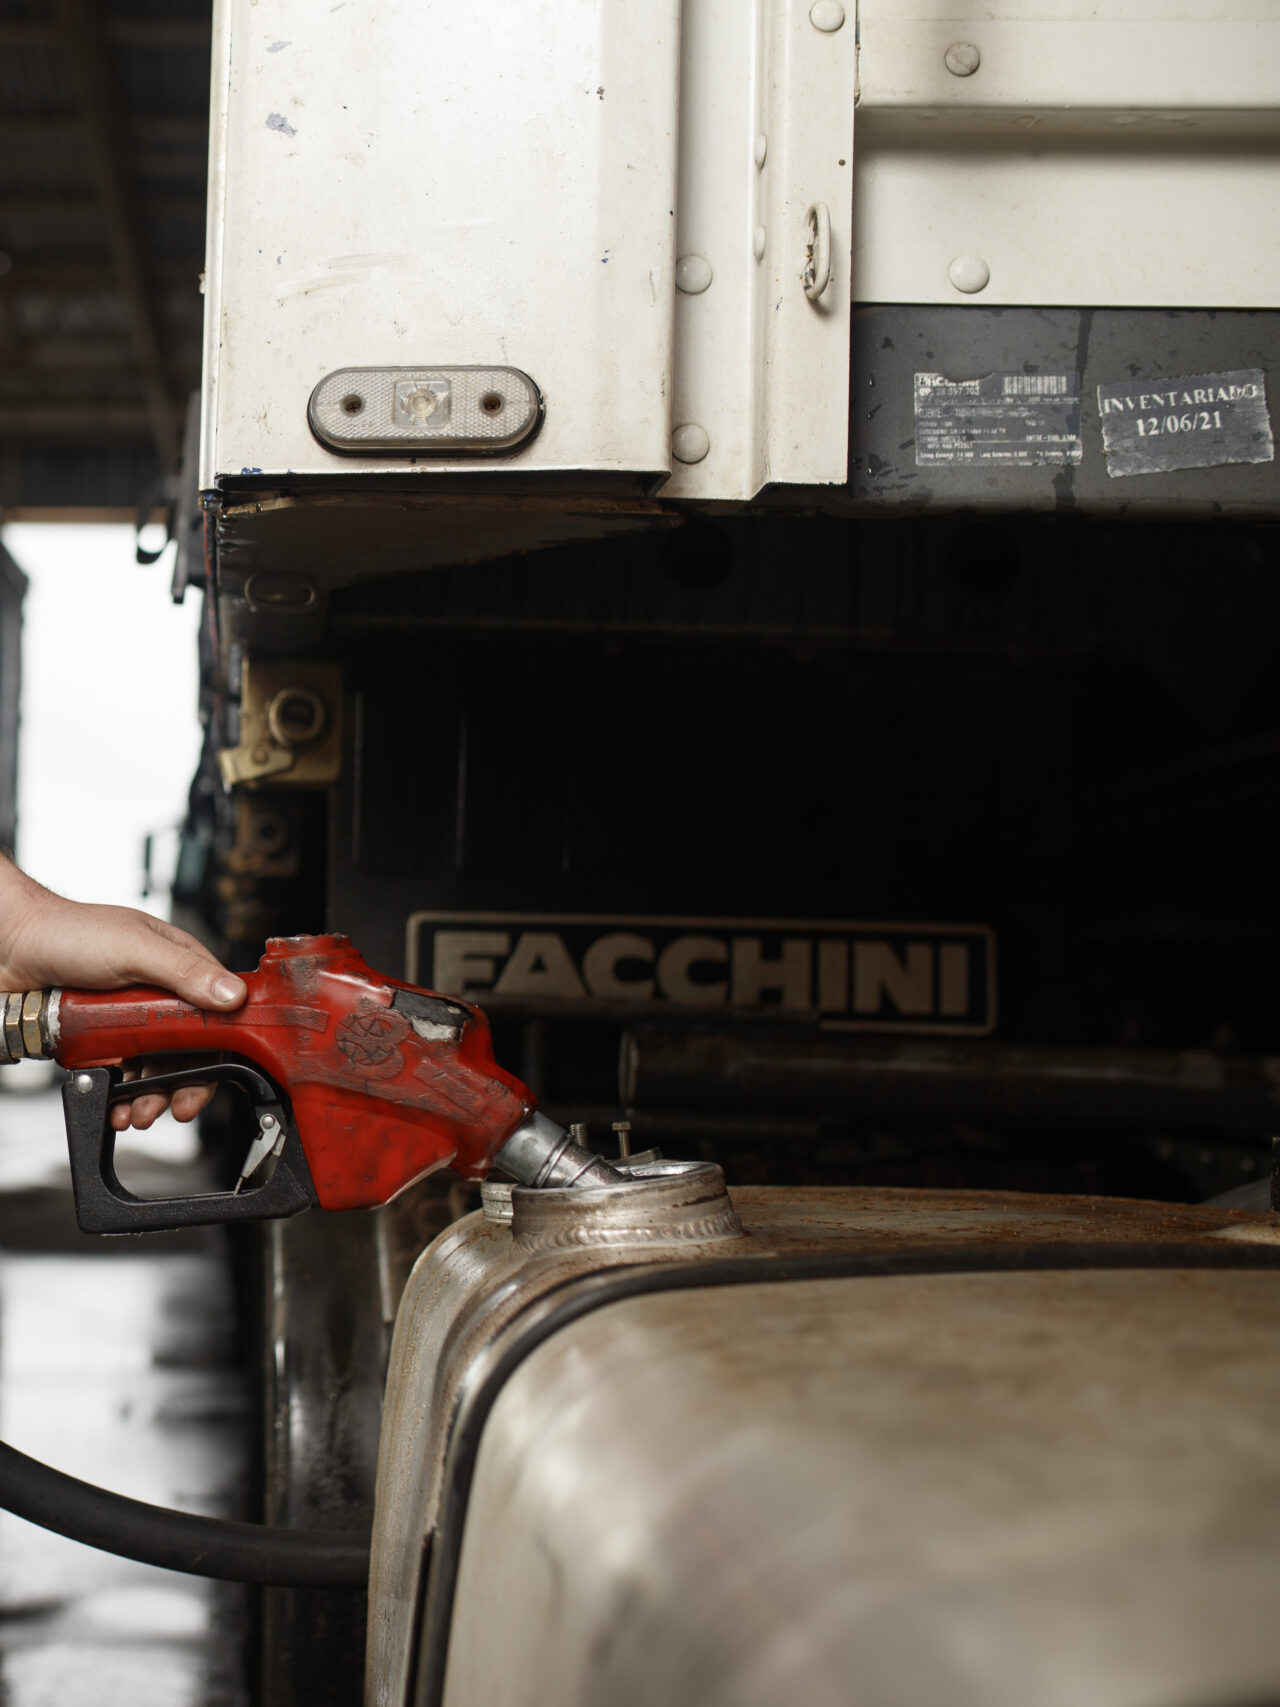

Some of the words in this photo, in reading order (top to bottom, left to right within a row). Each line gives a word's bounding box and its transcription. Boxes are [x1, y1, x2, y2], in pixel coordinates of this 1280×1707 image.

[1102, 383, 1259, 414] INVENTARIADO
[1135, 410, 1223, 437] 12/06/21
[433, 929, 970, 1017] FACCHINI
